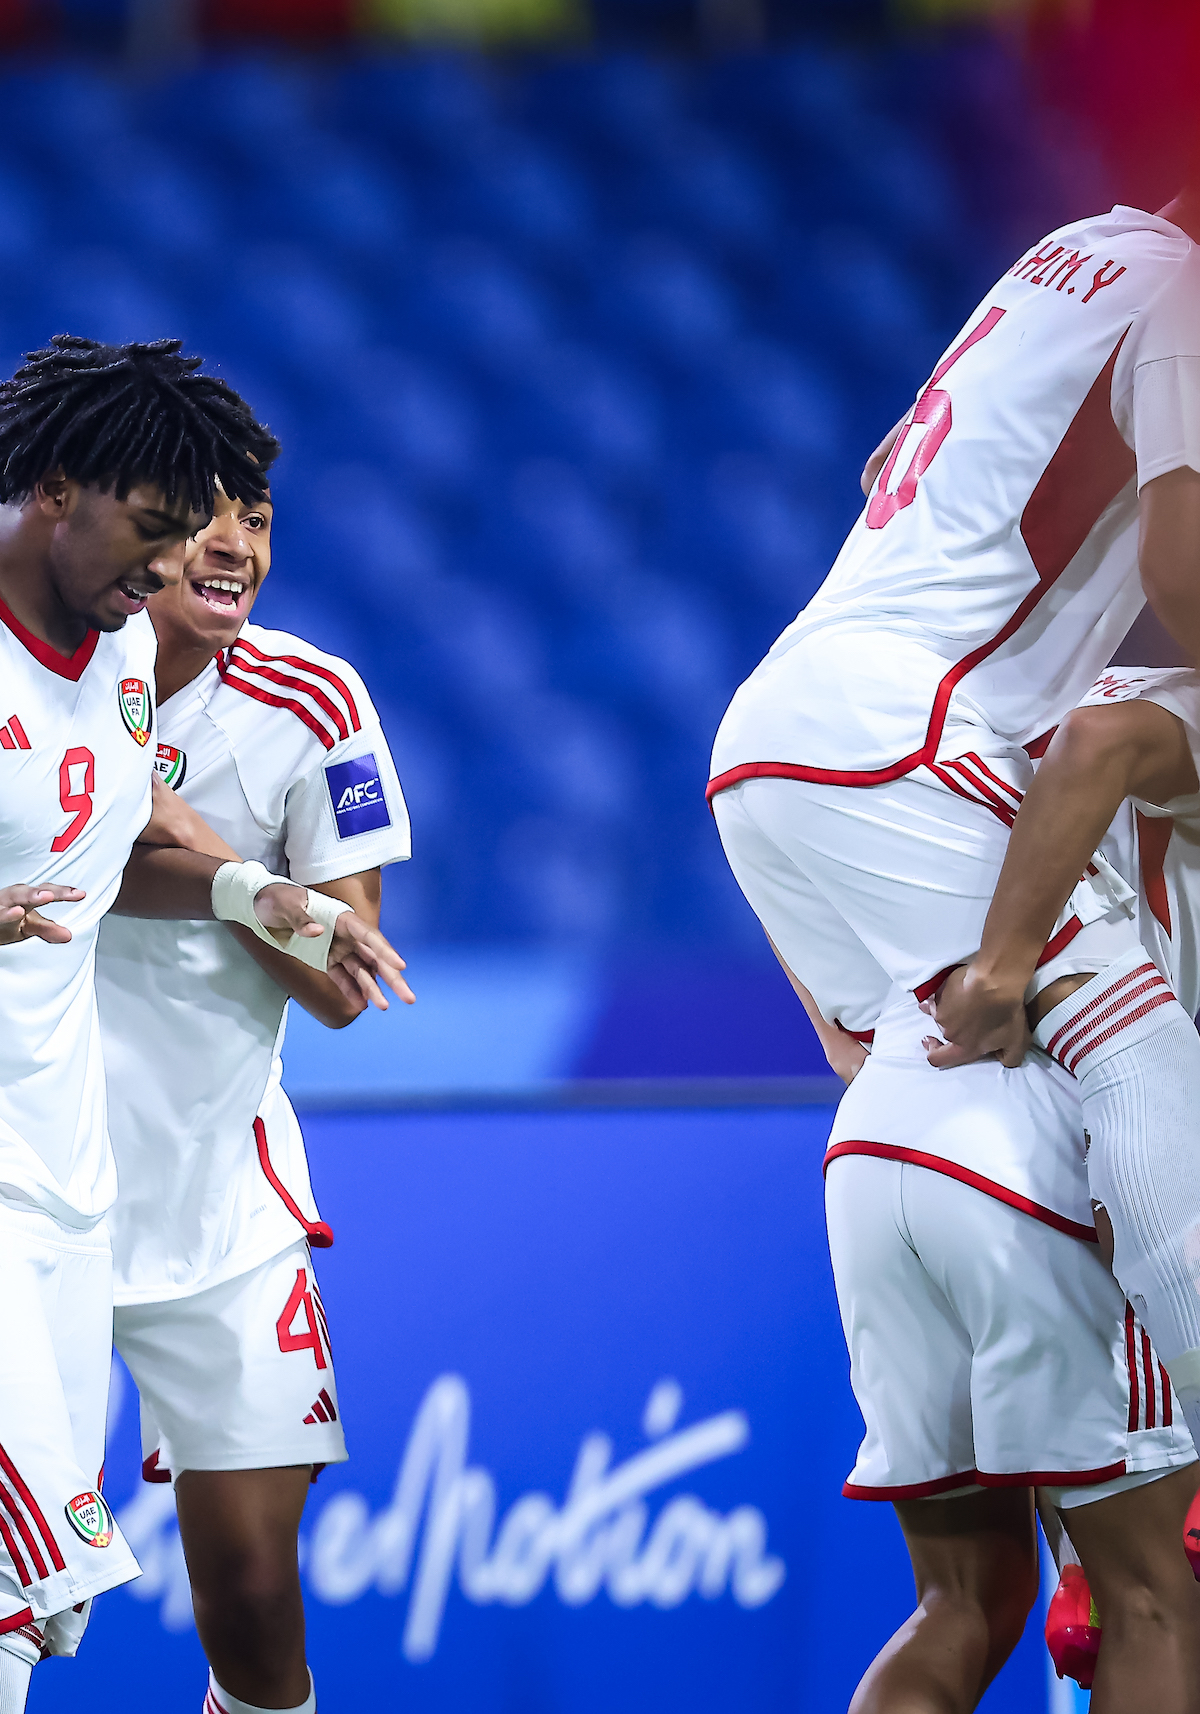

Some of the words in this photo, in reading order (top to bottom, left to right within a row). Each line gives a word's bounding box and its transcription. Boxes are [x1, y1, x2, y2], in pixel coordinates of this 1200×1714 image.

[866, 306, 1007, 530] 6
[126, 697, 141, 706] UAE
[131, 708, 140, 716] FA
[50, 746, 95, 852] 9
[336, 780, 378, 809] AFC
[276, 1268, 327, 1370] 4
[79, 1506, 97, 1520] UAE
[86, 1517, 97, 1526] FA
